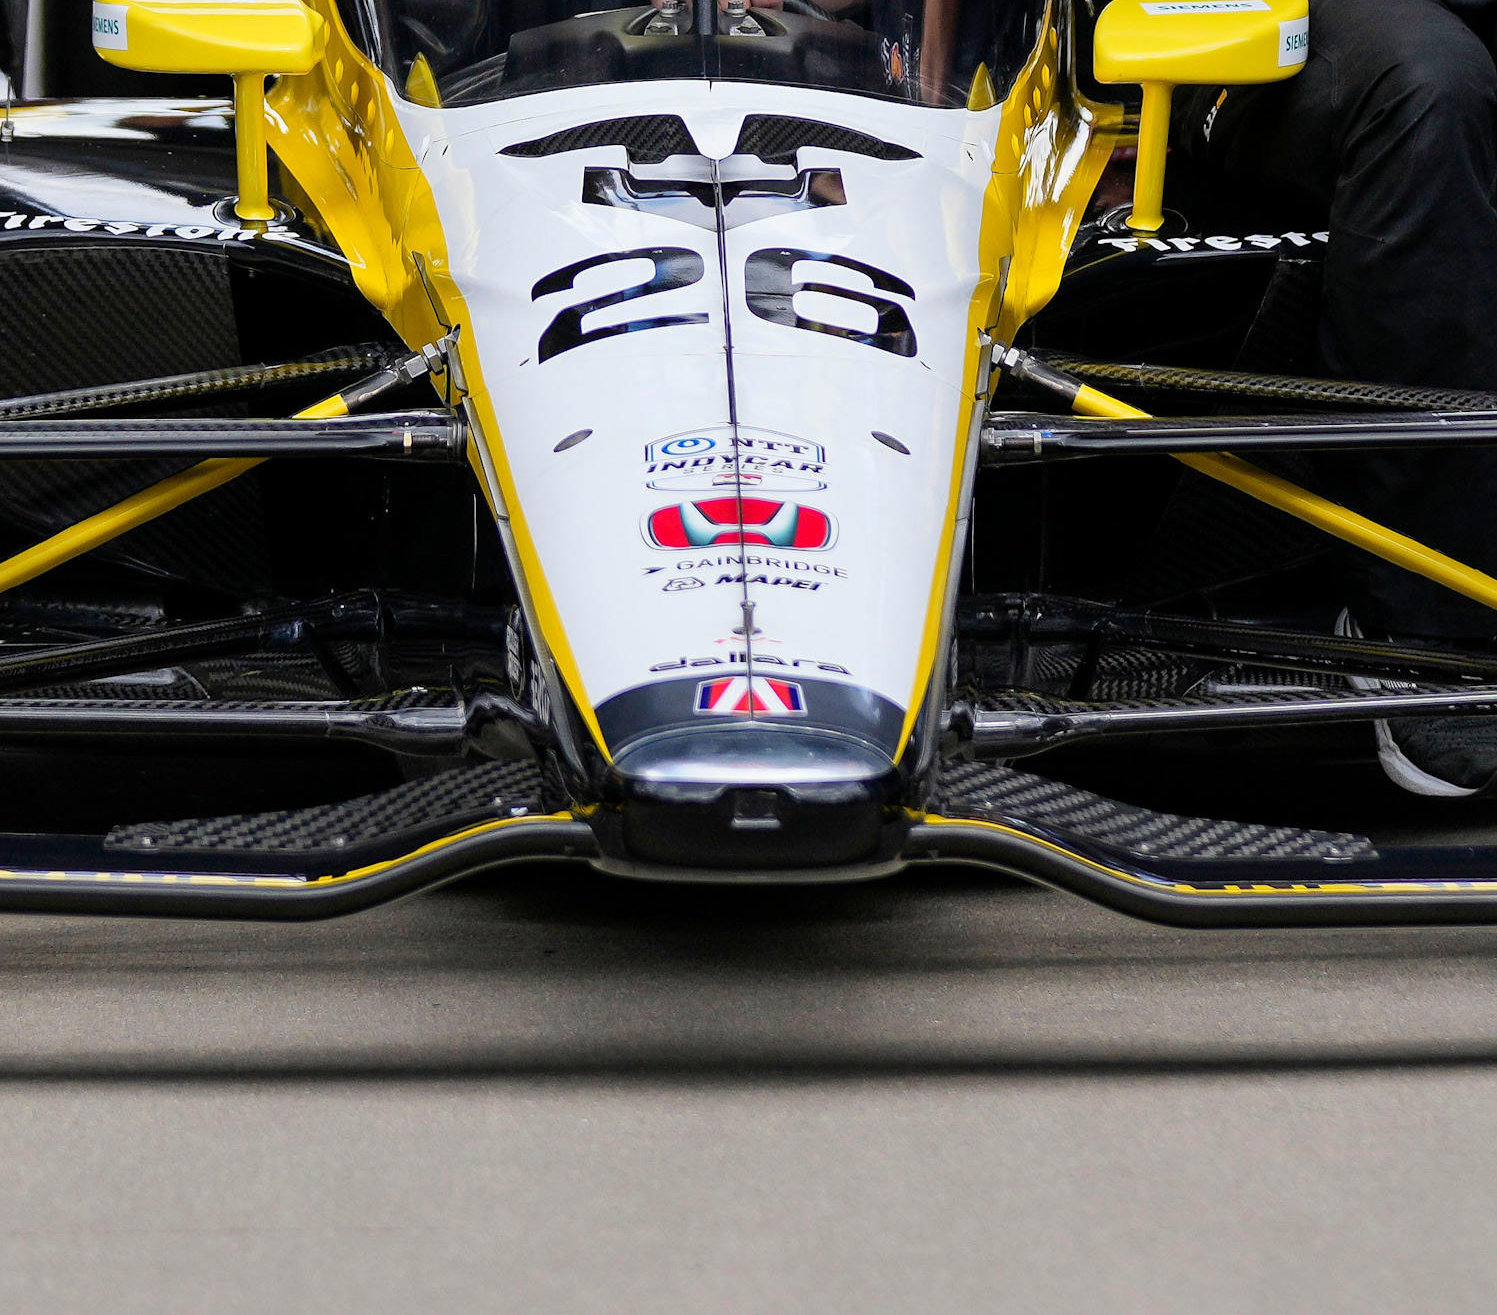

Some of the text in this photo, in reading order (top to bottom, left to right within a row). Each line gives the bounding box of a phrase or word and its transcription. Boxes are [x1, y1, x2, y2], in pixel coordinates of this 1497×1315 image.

[1157, 2, 1253, 11] SIEMENS
[531, 247, 918, 364] 26
[729, 437, 809, 454] NTT
[647, 454, 825, 474] INDYCAR
[682, 463, 785, 474] SERIES
[676, 555, 848, 579] GAINBRIDGE
[715, 573, 825, 591] MAPEI
[649, 651, 853, 676] dallara
